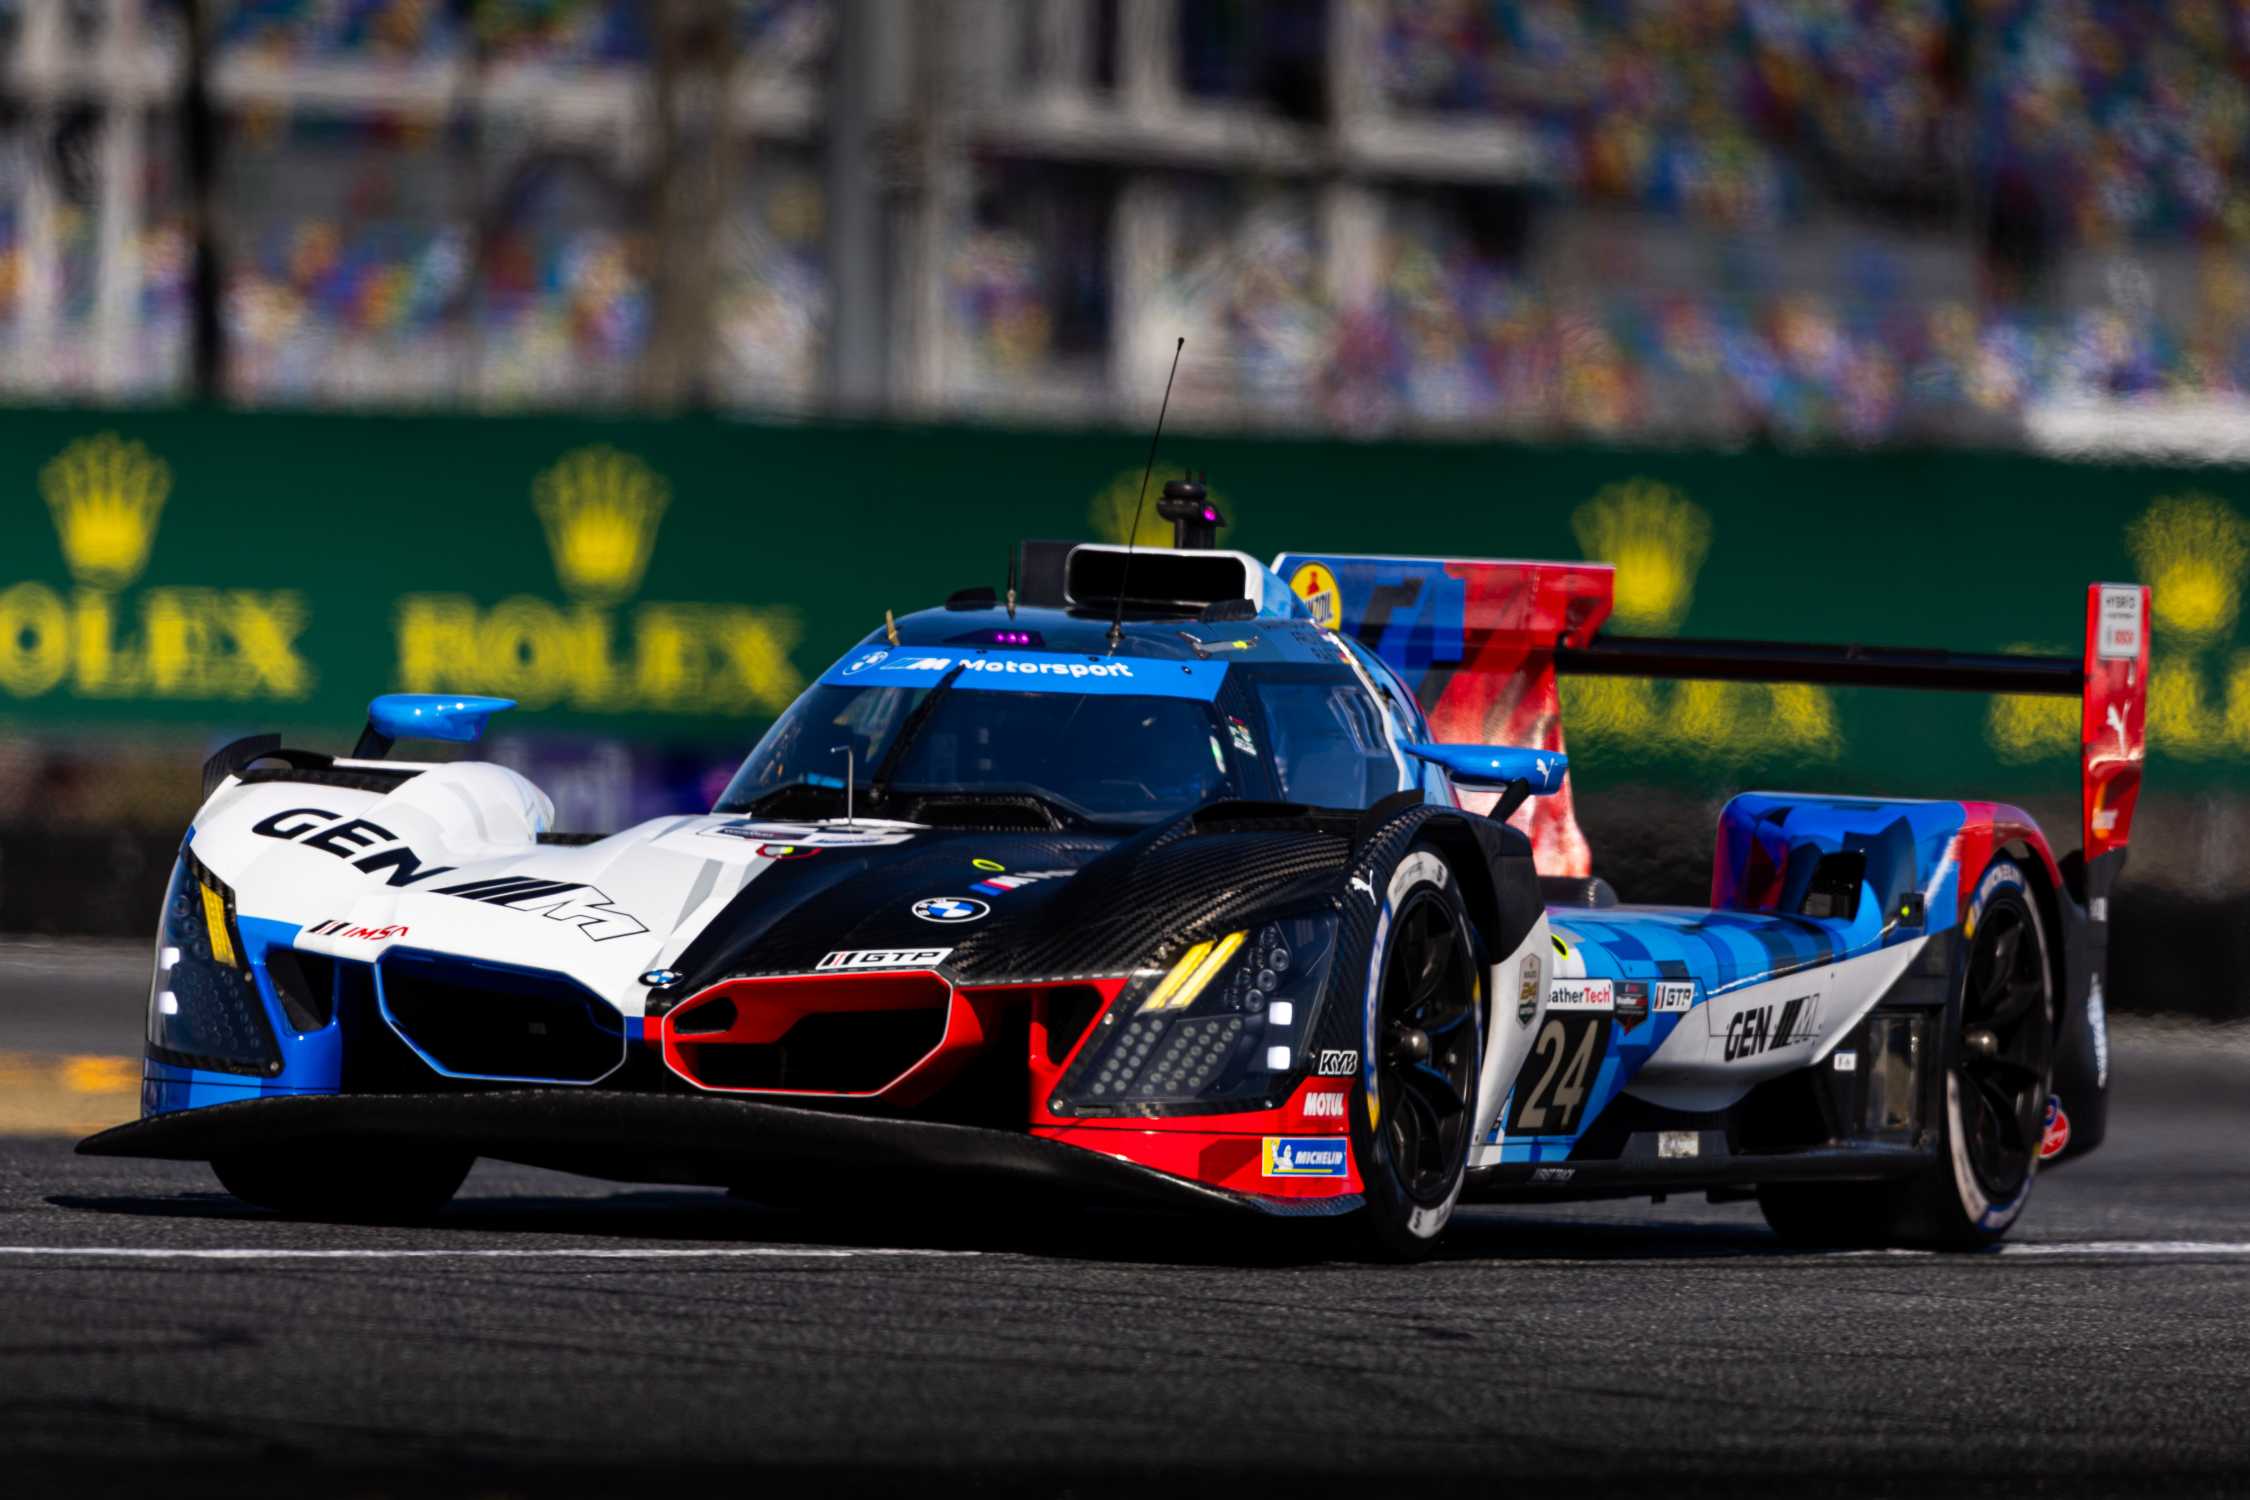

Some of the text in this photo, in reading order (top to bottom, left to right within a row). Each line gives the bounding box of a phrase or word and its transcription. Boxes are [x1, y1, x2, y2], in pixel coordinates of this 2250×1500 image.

[0, 582, 310, 700] OLEX
[396, 600, 802, 712] ROLEX
[958, 659, 1134, 678] Motorsport
[252, 808, 459, 888] GEN
[859, 951, 942, 963] GTP
[1549, 985, 1611, 1004] atherTech
[1664, 987, 1693, 1007] GTP
[1724, 1004, 1774, 1062] GEN
[1318, 1050, 1358, 1075] KYB
[1517, 1019, 1599, 1131] 24
[1303, 1092, 1345, 1117] MOTUL
[1294, 1151, 1344, 1165] MICHELIN
